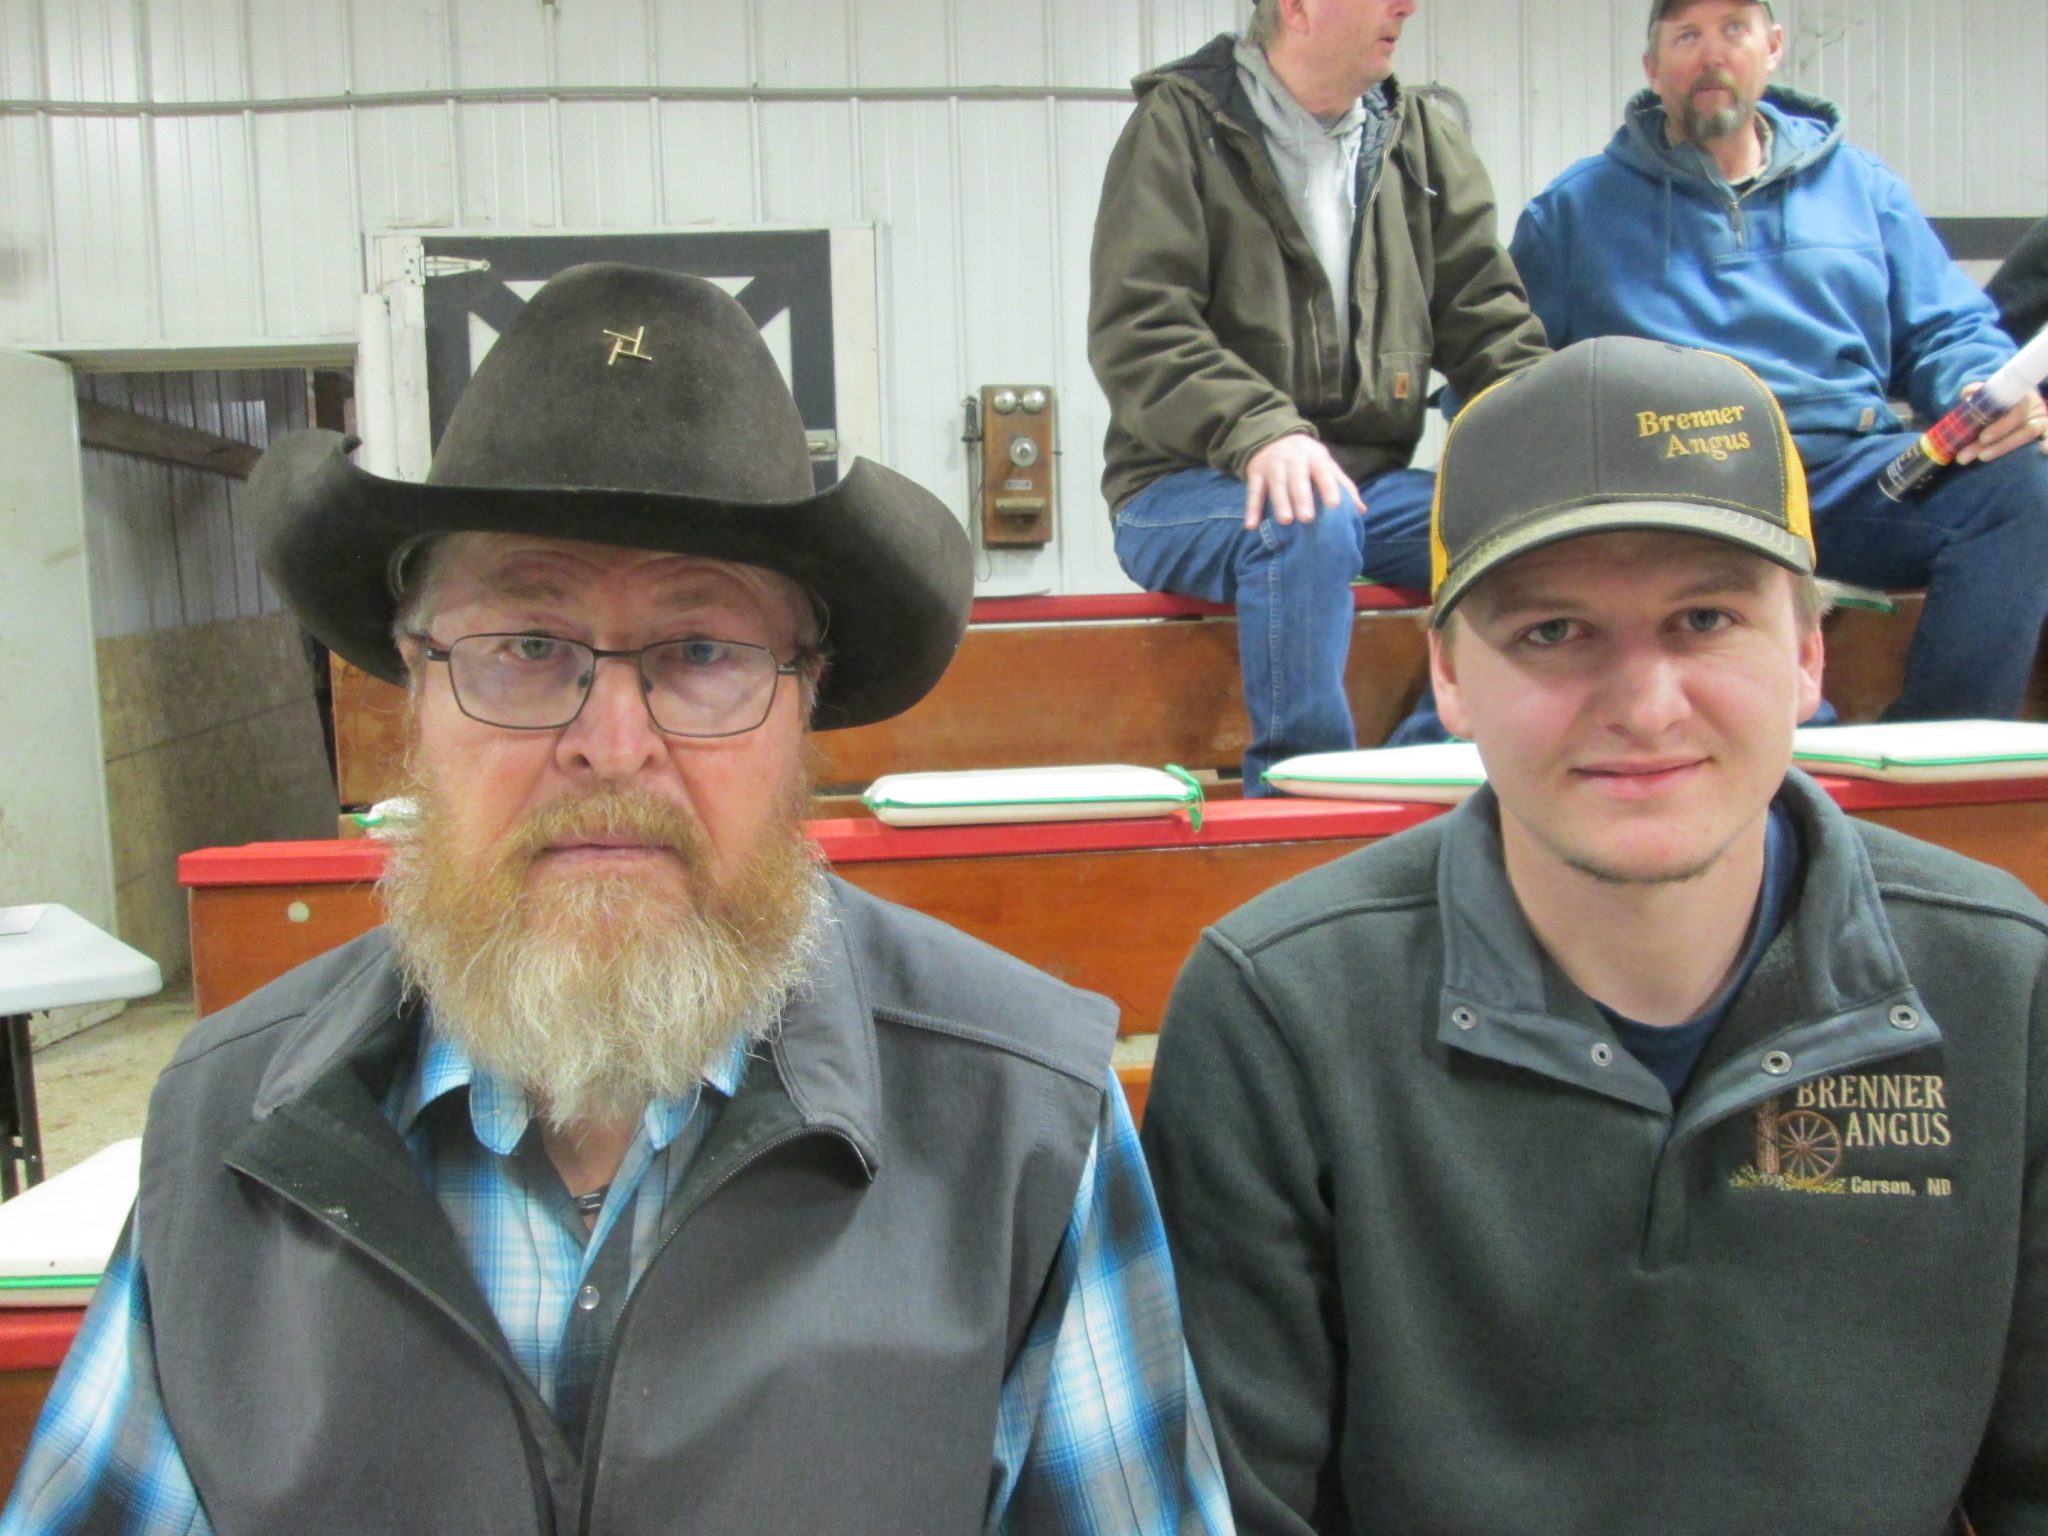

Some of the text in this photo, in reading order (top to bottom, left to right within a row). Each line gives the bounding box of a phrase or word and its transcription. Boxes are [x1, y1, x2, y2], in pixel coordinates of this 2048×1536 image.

[1636, 405, 1745, 437] Brenner
[1664, 432, 1751, 461] Angus
[1796, 1075, 1946, 1109] BRENNER
[1845, 1112, 1951, 1147] ANGUS
[1926, 1178, 1951, 1196] ND
